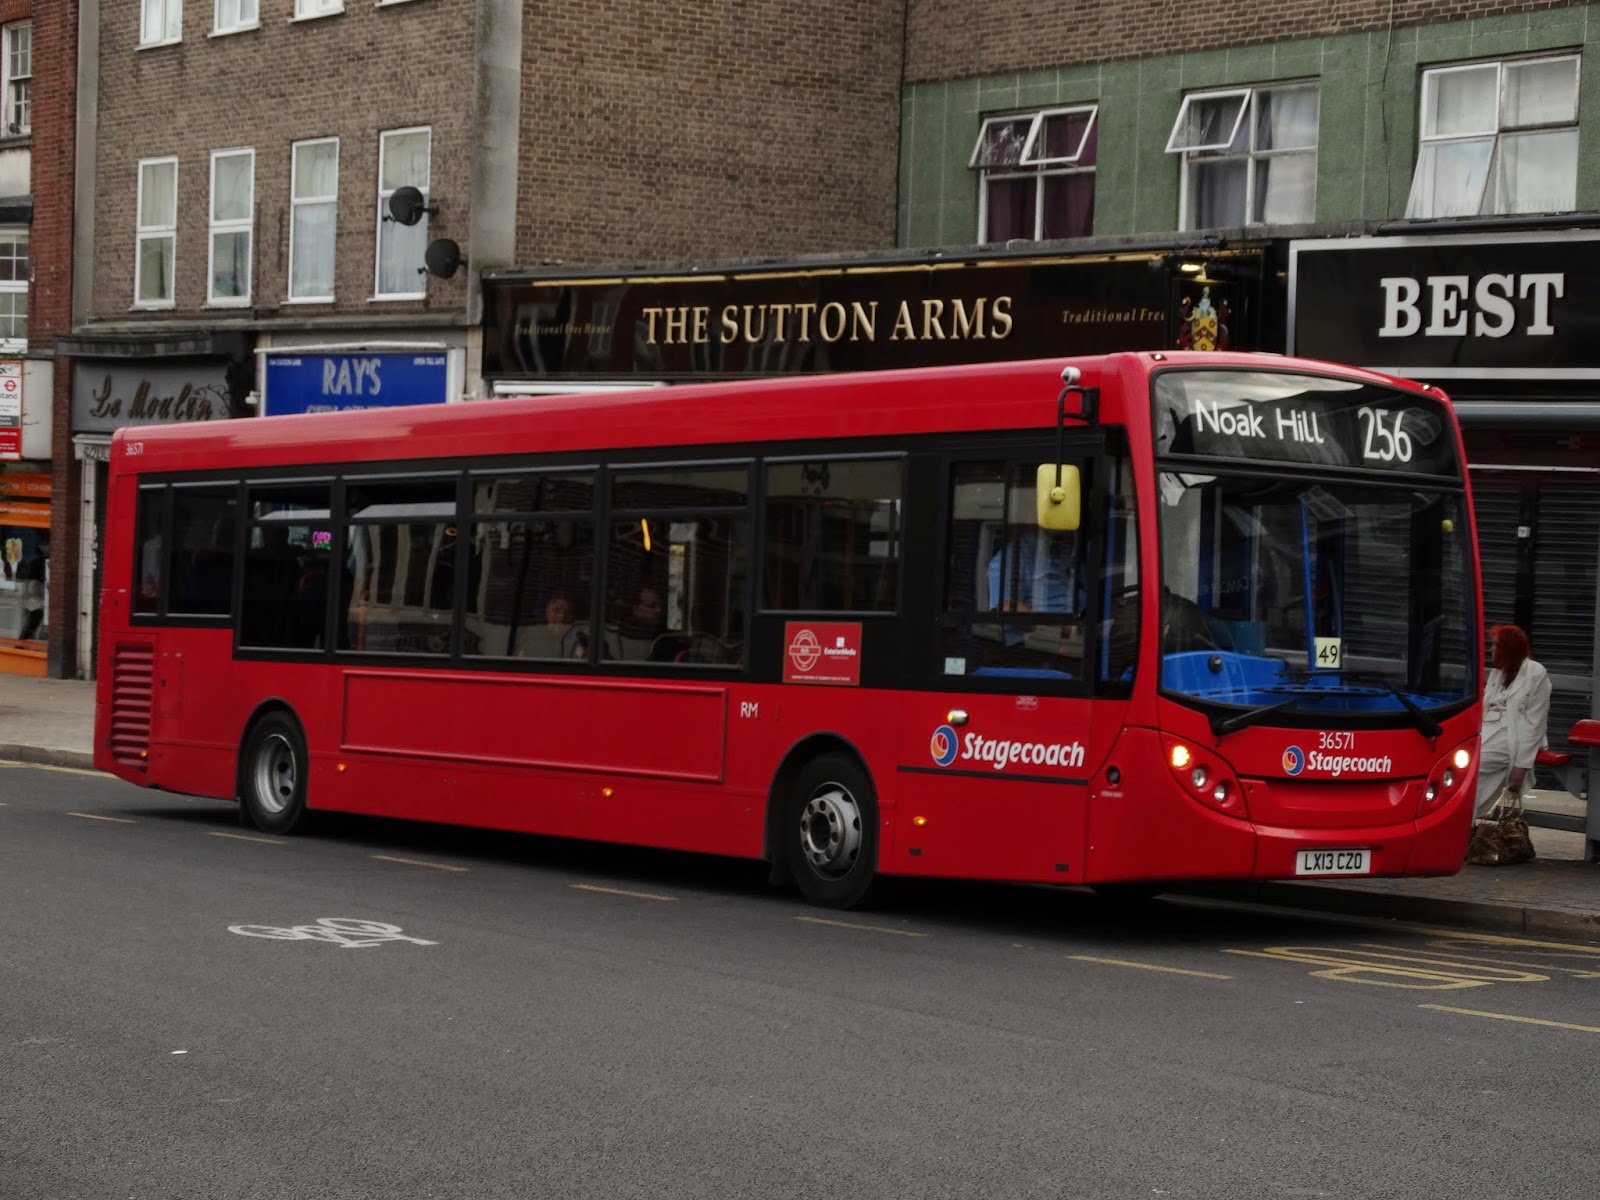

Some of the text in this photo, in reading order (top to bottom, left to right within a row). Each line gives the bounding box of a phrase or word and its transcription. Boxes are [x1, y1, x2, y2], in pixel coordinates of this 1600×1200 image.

[642, 296, 1013, 345] THE SUTTON ARMS
[1062, 308, 1137, 323] Traditional
[1378, 272, 1565, 338] BEST
[128, 379, 213, 421] Moulin
[1195, 399, 1325, 445] Noak Hill
[1357, 405, 1413, 464] 256
[1318, 644, 1339, 665] 49
[740, 701, 759, 719] RM
[962, 731, 1086, 770] Stagecoach
[1318, 731, 1355, 750] 36571
[1307, 750, 1392, 777] Stagecoach
[1304, 852, 1363, 871] LX13 CZO
